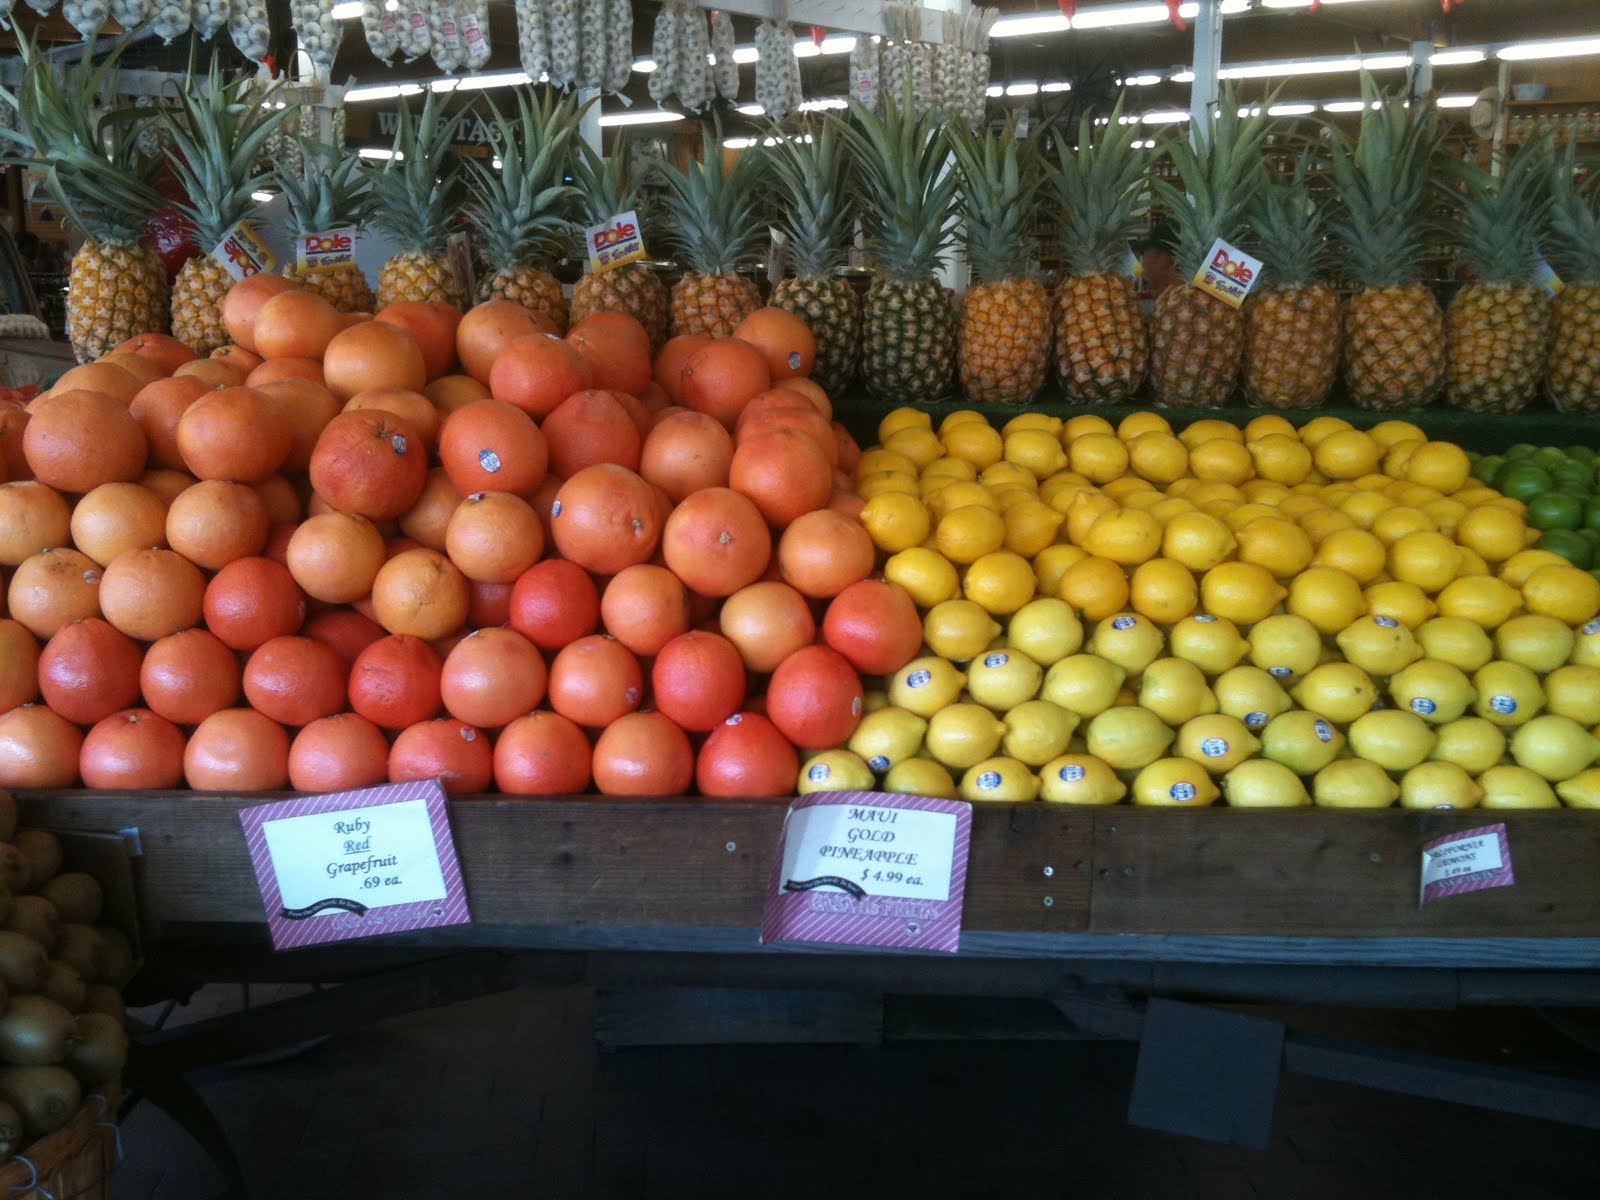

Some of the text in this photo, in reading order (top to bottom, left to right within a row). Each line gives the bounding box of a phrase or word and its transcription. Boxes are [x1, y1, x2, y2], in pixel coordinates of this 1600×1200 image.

[305, 234, 353, 252] Dole
[593, 222, 636, 249] Dole
[1211, 248, 1253, 284] Dole
[848, 808, 899, 824] MAUI
[333, 817, 371, 835] Ruby
[343, 836, 371, 852] Red
[847, 828, 896, 844] GOLD
[819, 845, 918, 866] PINEAPPLE
[326, 855, 399, 878] Grapefruit
[360, 875, 403, 890] .69 ea.
[861, 868, 924, 886] $ 4.99 ea.
